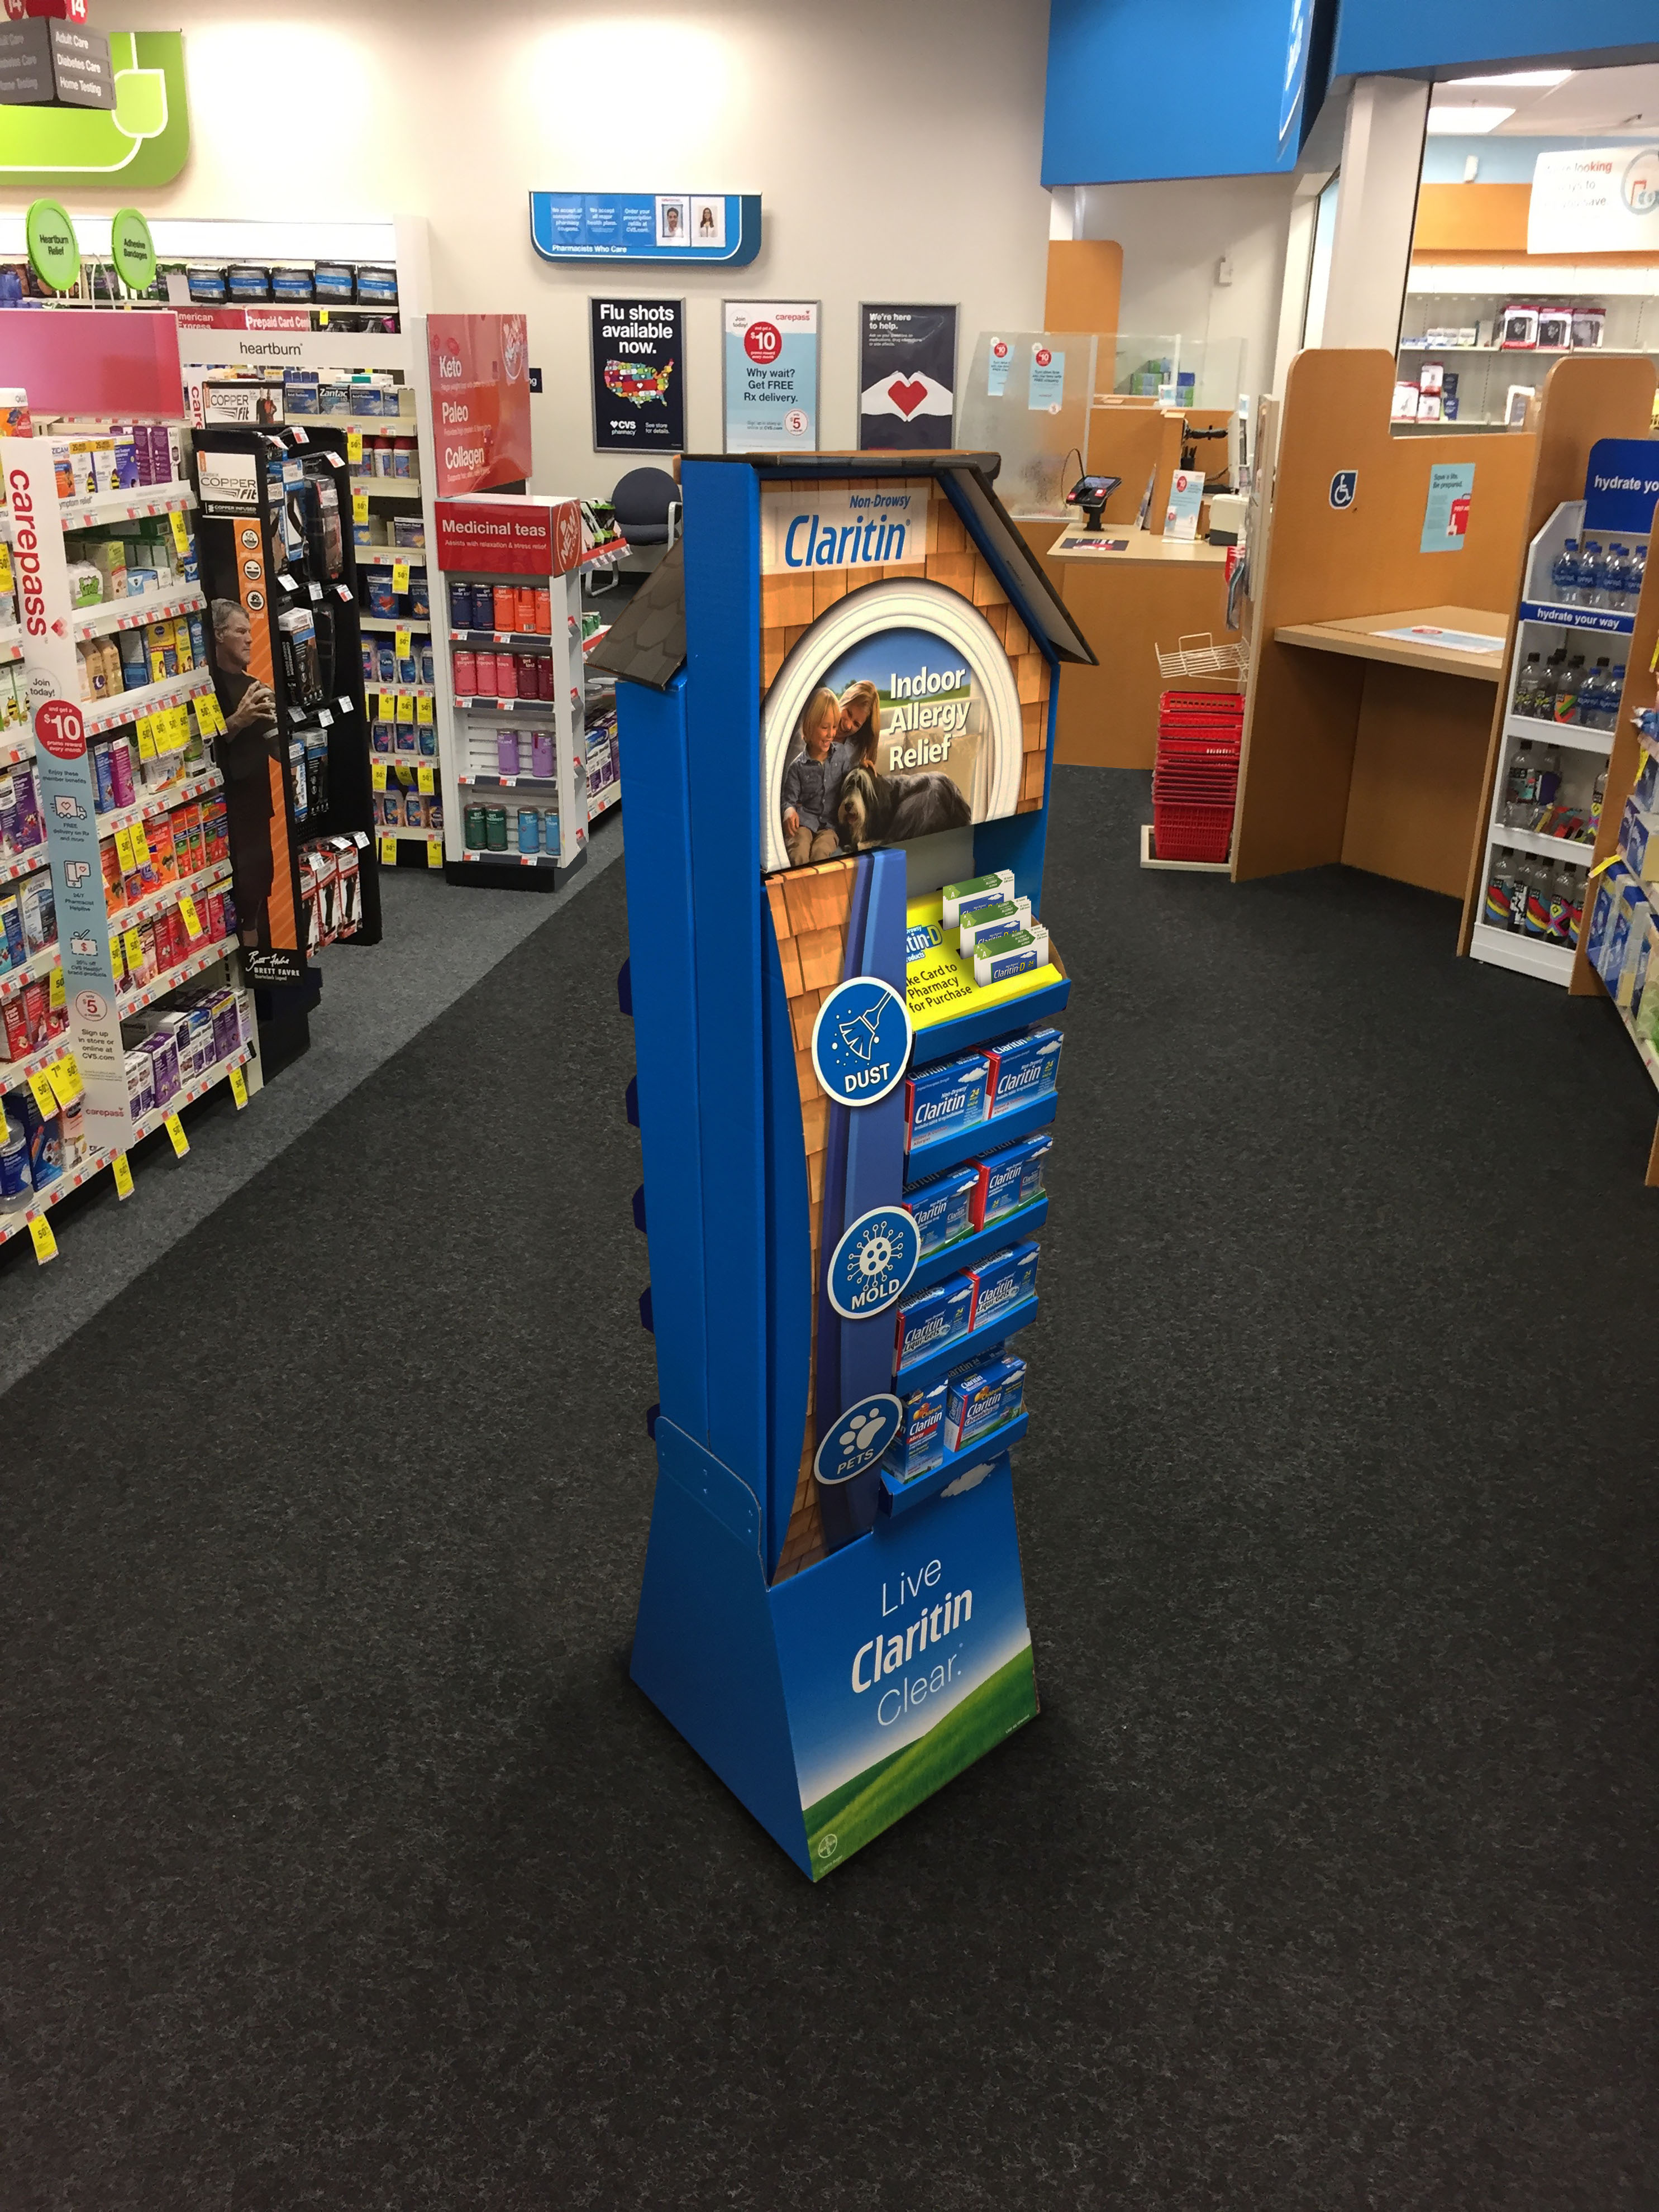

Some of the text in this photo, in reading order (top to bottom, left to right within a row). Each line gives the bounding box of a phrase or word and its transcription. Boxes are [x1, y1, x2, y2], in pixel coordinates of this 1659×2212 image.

[55, 31, 89, 49] Adult Care
[57, 53, 101, 73] Diabetes Care
[59, 76, 102, 97] Home Testing
[178, 313, 294, 330] merican Prepaid Card
[600, 304, 674, 321] Flu shots
[602, 323, 673, 339] available
[879, 322, 898, 331] help.
[239, 341, 302, 355] heartburn
[619, 341, 657, 354] now.
[440, 355, 462, 378] Keto
[747, 368, 795, 379] Why wait?
[320, 389, 348, 398] Zantac
[749, 381, 793, 390] Get FREE
[211, 393, 249, 406] COPPER
[744, 393, 798, 403] Rx delivery.
[237, 406, 250, 421] fit
[442, 401, 469, 425] Paleo
[618, 421, 636, 429] CVS
[445, 446, 485, 470] Collagen
[201, 477, 256, 488] COPPER
[1594, 475, 1659, 494] hydrate yo
[240, 488, 257, 500] fit
[850, 494, 912, 509] Non-Drowsy
[442, 519, 546, 537] Medicinal teas
[784, 513, 907, 568] Claritin
[9, 469, 47, 636] carepass
[1537, 608, 1619, 630] hydrate your way
[32, 678, 50, 687] Join
[890, 666, 966, 700] Indoor
[30, 688, 55, 697] today!
[889, 700, 971, 735] Allergy
[889, 734, 953, 772] Relief
[920, 962, 957, 981] Card to
[994, 962, 1025, 979] Claritin-D
[907, 975, 960, 999] Pharmacy
[909, 985, 972, 1013] for Purchase
[992, 1038, 1028, 1055] Claritin
[845, 1062, 890, 1093] DUST
[997, 1065, 1042, 1094] Claritin
[85, 1107, 124, 1117] carepass
[915, 1093, 966, 1124] Claritin
[989, 1166, 1021, 1189] Claritin
[851, 1279, 900, 1310] MOLD
[979, 1279, 1013, 1305] Claritin
[904, 1316, 943, 1345] Claritin
[961, 1375, 983, 1389] Claritin
[967, 1393, 1002, 1418] Claritin
[909, 1411, 942, 1436] Claritin
[837, 1447, 874, 1475] PETS
[881, 1559, 942, 1618] Live
[851, 1589, 973, 1694] Claritin
[877, 1652, 962, 1727] Clear.
